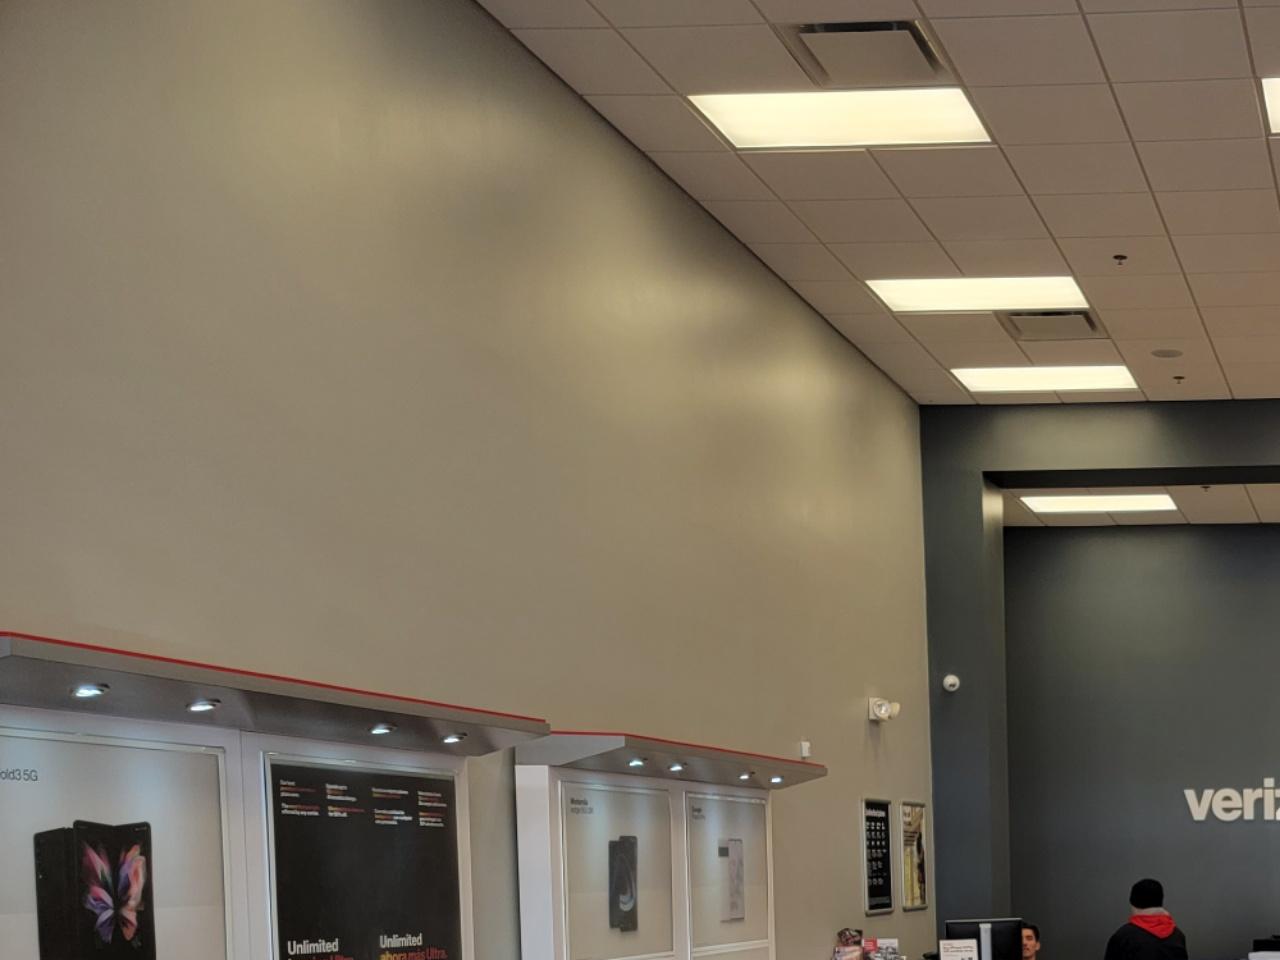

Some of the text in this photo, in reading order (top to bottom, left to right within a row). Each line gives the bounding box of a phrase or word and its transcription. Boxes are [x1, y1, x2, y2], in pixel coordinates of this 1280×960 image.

[23, 768, 38, 781] 5G
[288, 938, 339, 955] Unlimited
[380, 933, 423, 949] Unlimited
